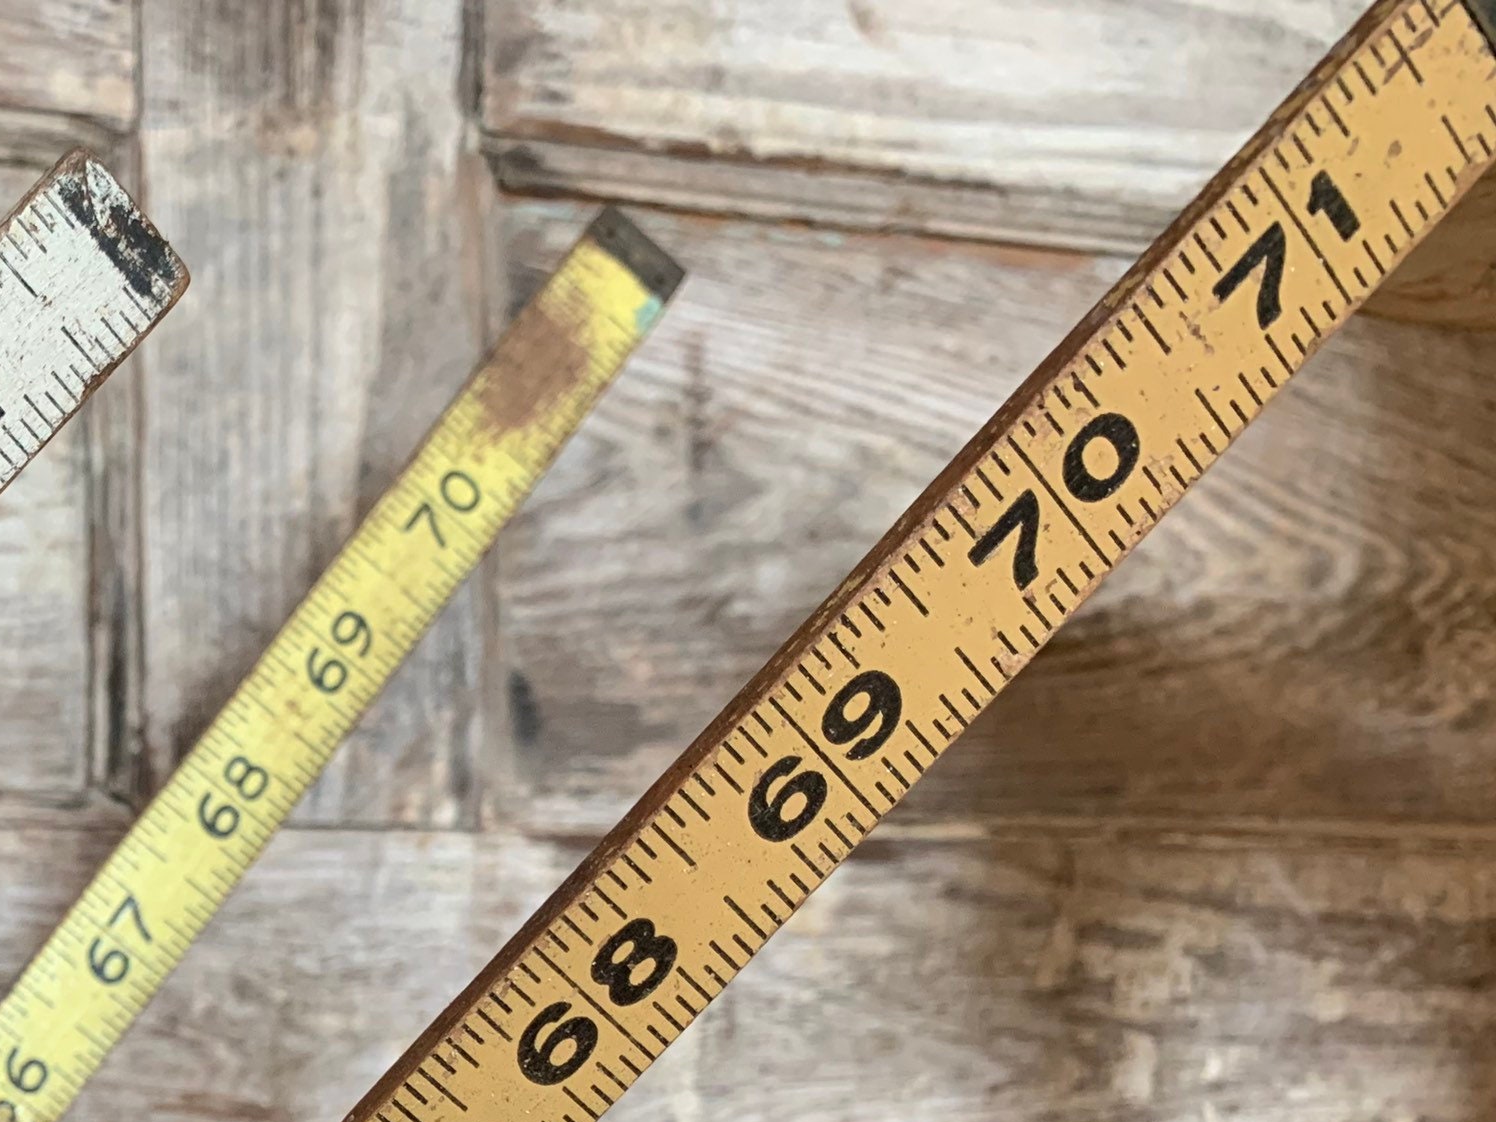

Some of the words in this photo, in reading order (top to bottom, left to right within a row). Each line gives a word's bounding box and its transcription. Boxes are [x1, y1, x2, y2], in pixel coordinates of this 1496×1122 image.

[87, 895, 155, 986] 67
[197, 753, 270, 841] 68
[304, 609, 374, 695] 69
[404, 469, 483, 549] 70
[516, 917, 679, 1087] 68
[747, 669, 903, 842] 69
[968, 412, 1141, 591] 70
[1211, 170, 1362, 330] 71
